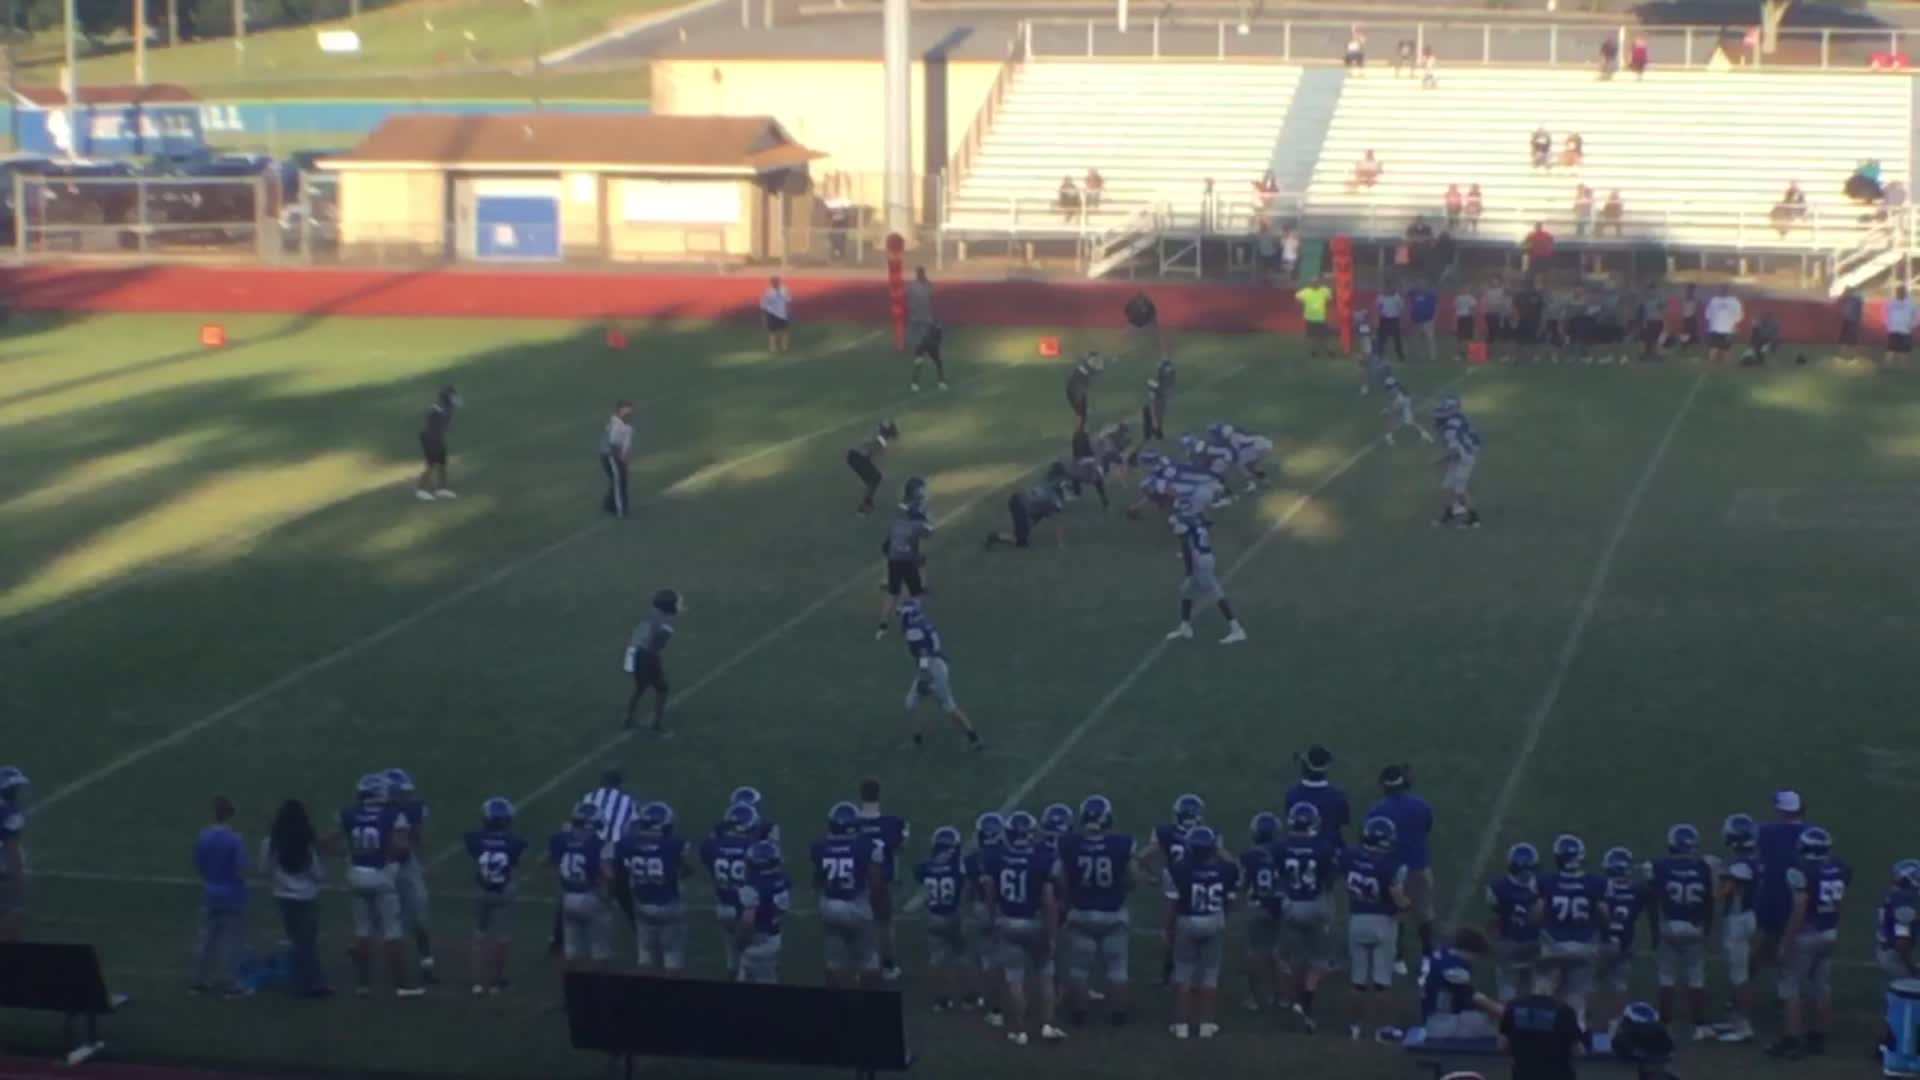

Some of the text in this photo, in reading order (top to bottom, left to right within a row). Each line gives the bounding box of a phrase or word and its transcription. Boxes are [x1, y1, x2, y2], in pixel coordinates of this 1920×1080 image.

[822, 857, 855, 890] 75
[1000, 868, 1028, 903] 61
[1077, 855, 1112, 888] 78
